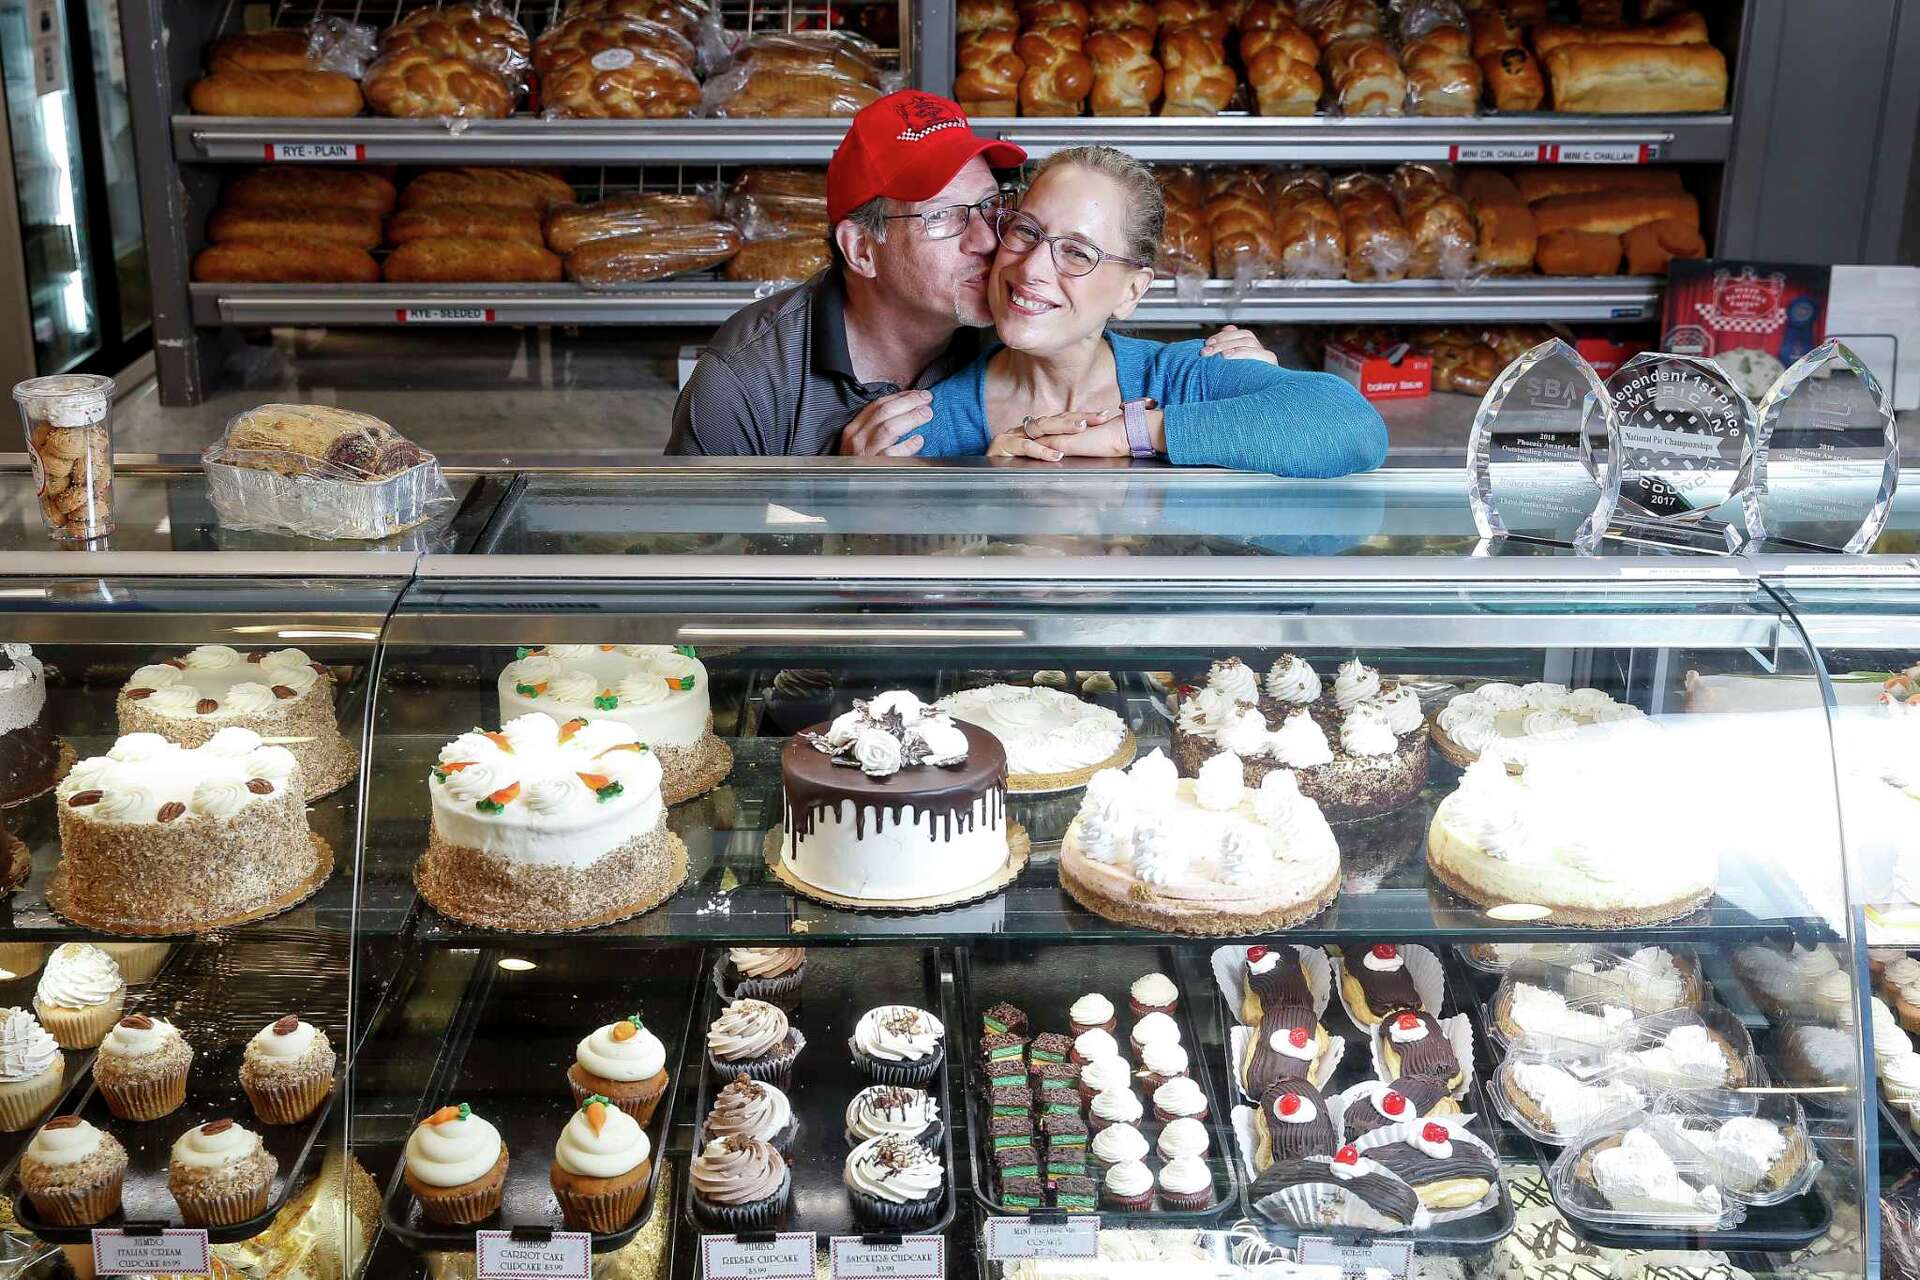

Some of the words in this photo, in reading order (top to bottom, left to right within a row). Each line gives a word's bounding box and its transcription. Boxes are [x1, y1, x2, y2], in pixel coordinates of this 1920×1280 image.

[283, 146, 304, 156] RYE
[315, 145, 347, 156] PLAIN
[411, 308, 432, 318] RYE
[440, 308, 481, 318] SEEDED
[1526, 377, 1577, 400] SBA
[1609, 369, 1688, 411] dependent
[1693, 376, 1717, 397] 1st
[1714, 393, 1740, 438] Place
[1618, 386, 1725, 434] AMERICAN
[1539, 433, 1556, 441] 2018
[1624, 432, 1652, 444] National
[1653, 436, 1663, 445] Pie
[1651, 494, 1676, 506] 2017
[518, 1241, 549, 1249] JUMBO
[744, 1242, 776, 1251] JUMBO
[118, 1248, 148, 1257] ITALIAN
[150, 1248, 182, 1257] CREAM
[500, 1249, 541, 1260] CARROT
[542, 1252, 565, 1262] CAKE
[891, 1252, 933, 1263] CUPCAKE
[118, 1260, 160, 1269] CUPCAKE
[757, 1254, 800, 1264] CUPCAKE
[500, 1261, 542, 1272] CUPCAKE
